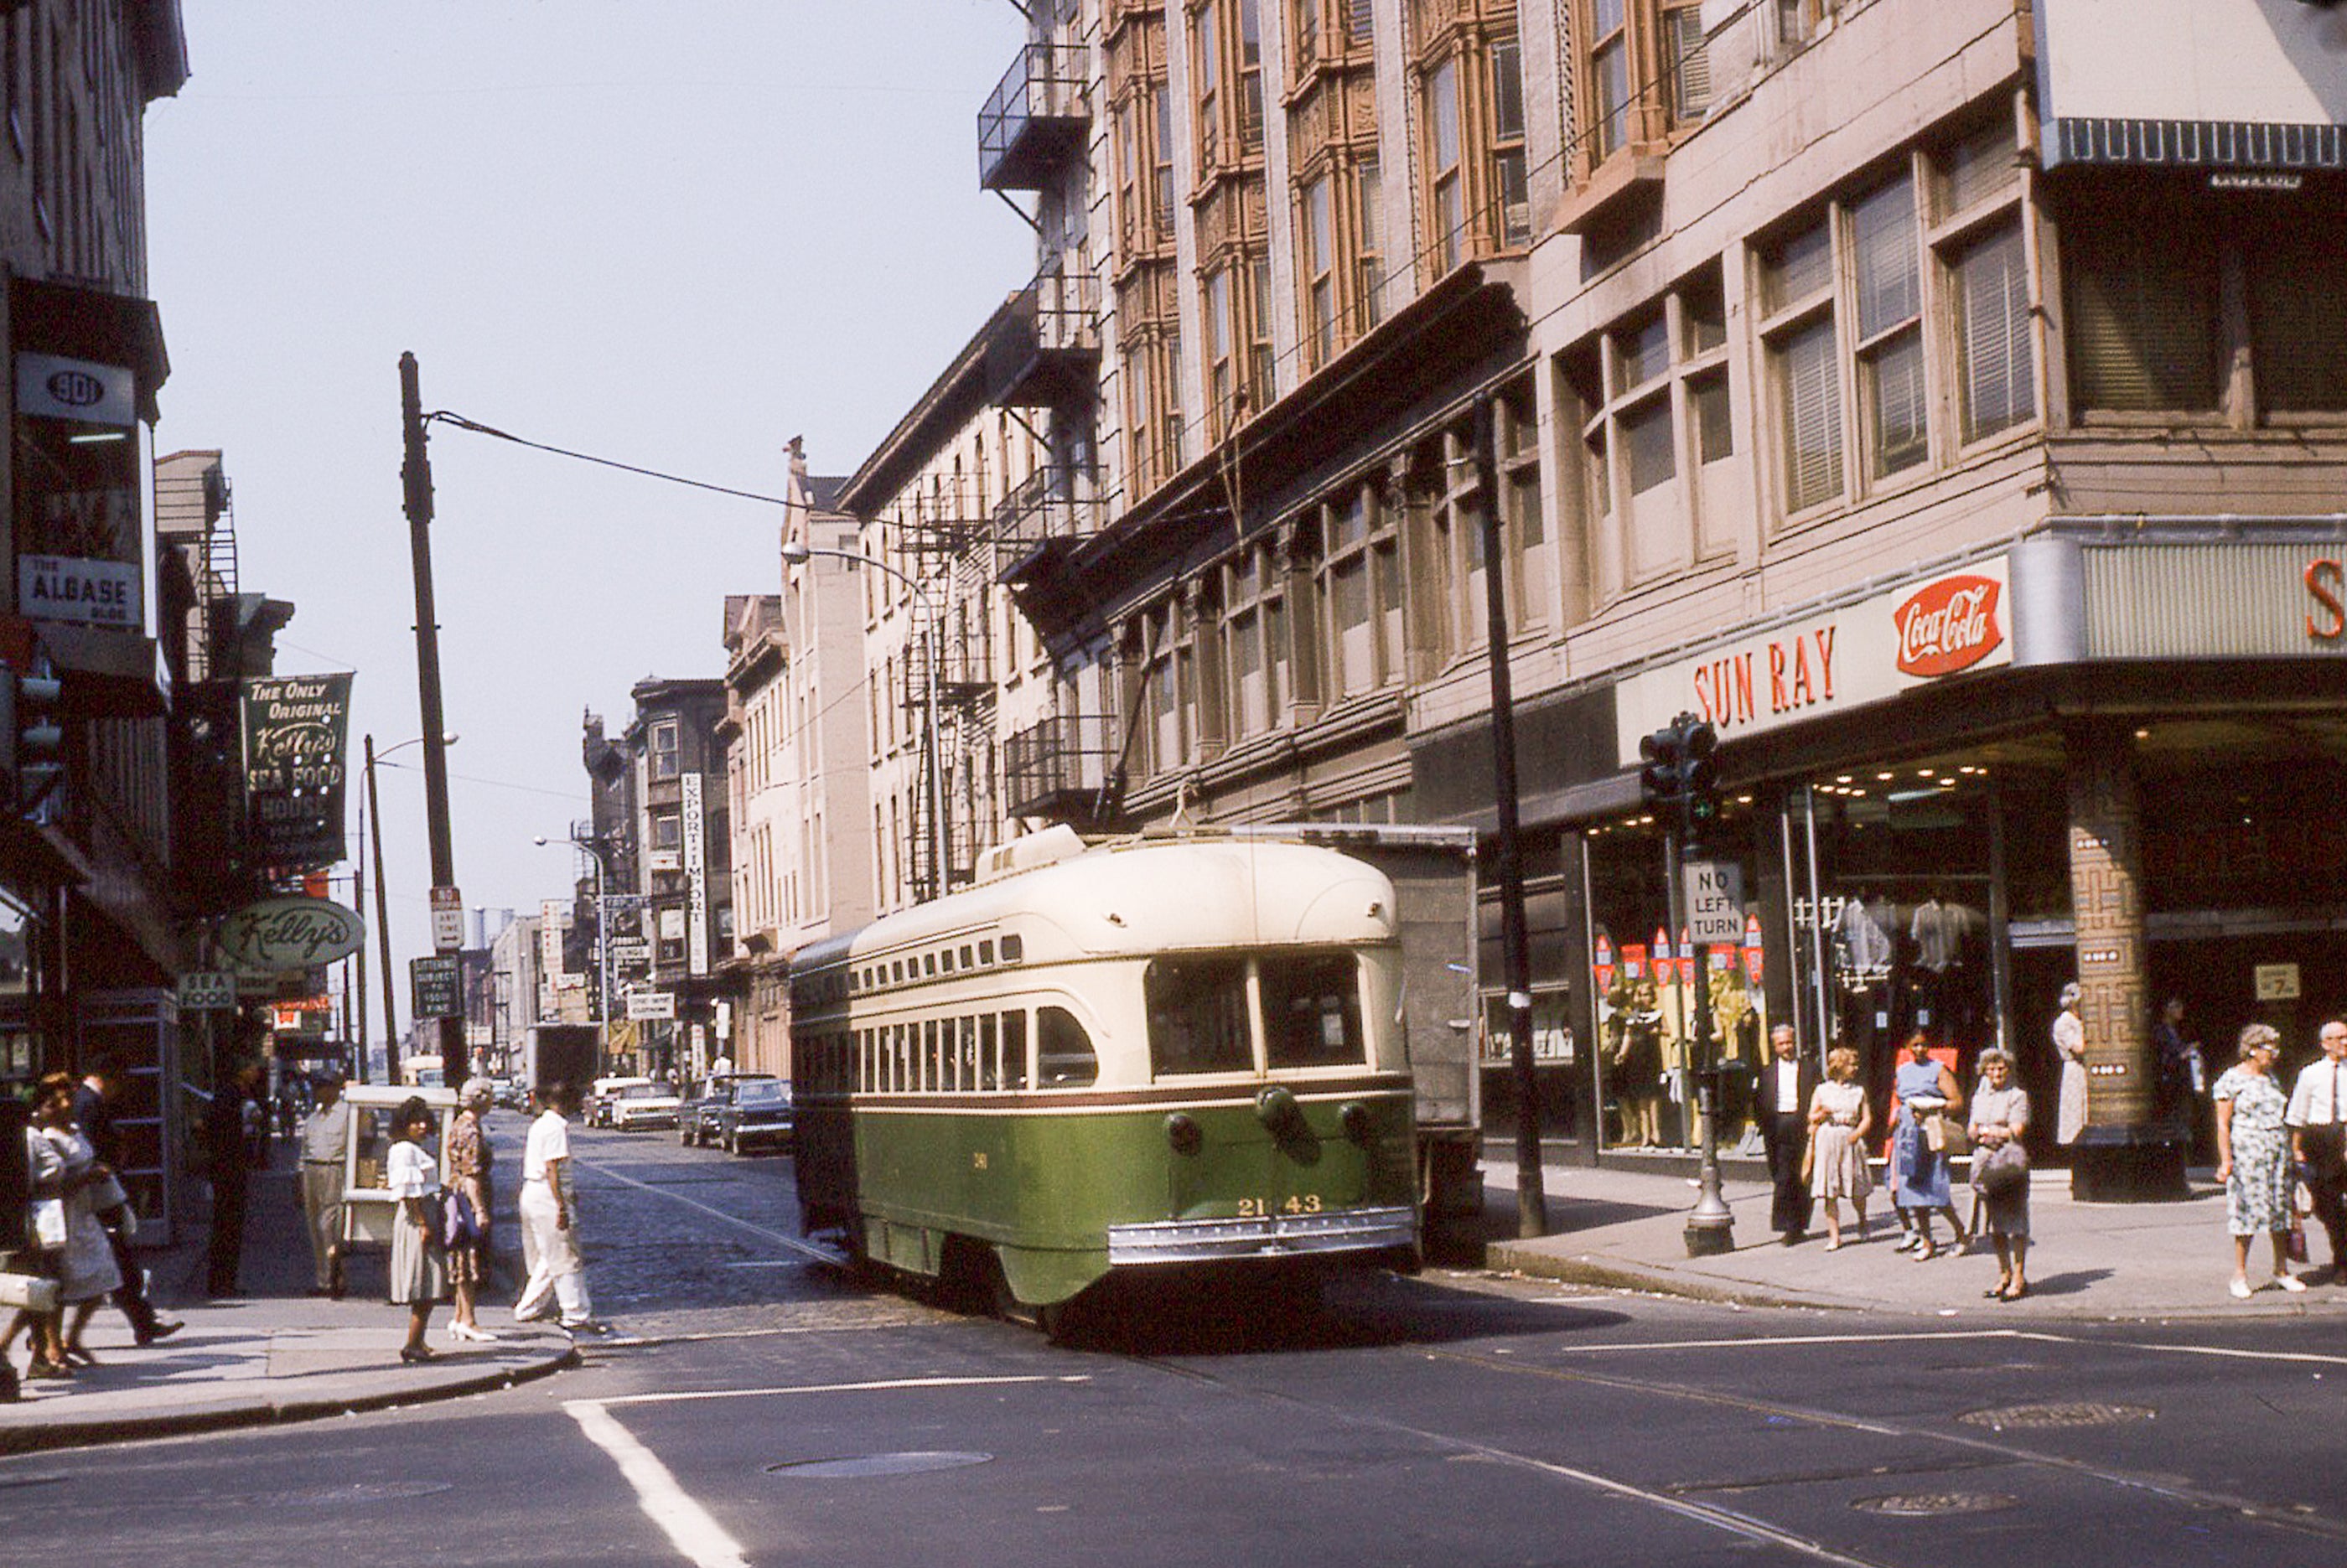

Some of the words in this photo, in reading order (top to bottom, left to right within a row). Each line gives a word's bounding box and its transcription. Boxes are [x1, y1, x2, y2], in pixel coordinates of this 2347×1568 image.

[1904, 584, 1990, 664] Coca-Cola
[1694, 651, 1755, 728] SUN
[1768, 624, 1837, 714] RAY
[269, 702, 341, 719] ORIGINAL
[249, 768, 283, 792] SEA
[292, 763, 342, 788] FOOD
[1698, 872, 1728, 890] NO
[1695, 897, 1733, 913] LEFT
[238, 906, 350, 961] Kelly's
[1693, 919, 1738, 935] TURN
[187, 975, 225, 990] SEA
[1238, 1198, 1264, 1216] 21
[1284, 1193, 1322, 1214] 43
